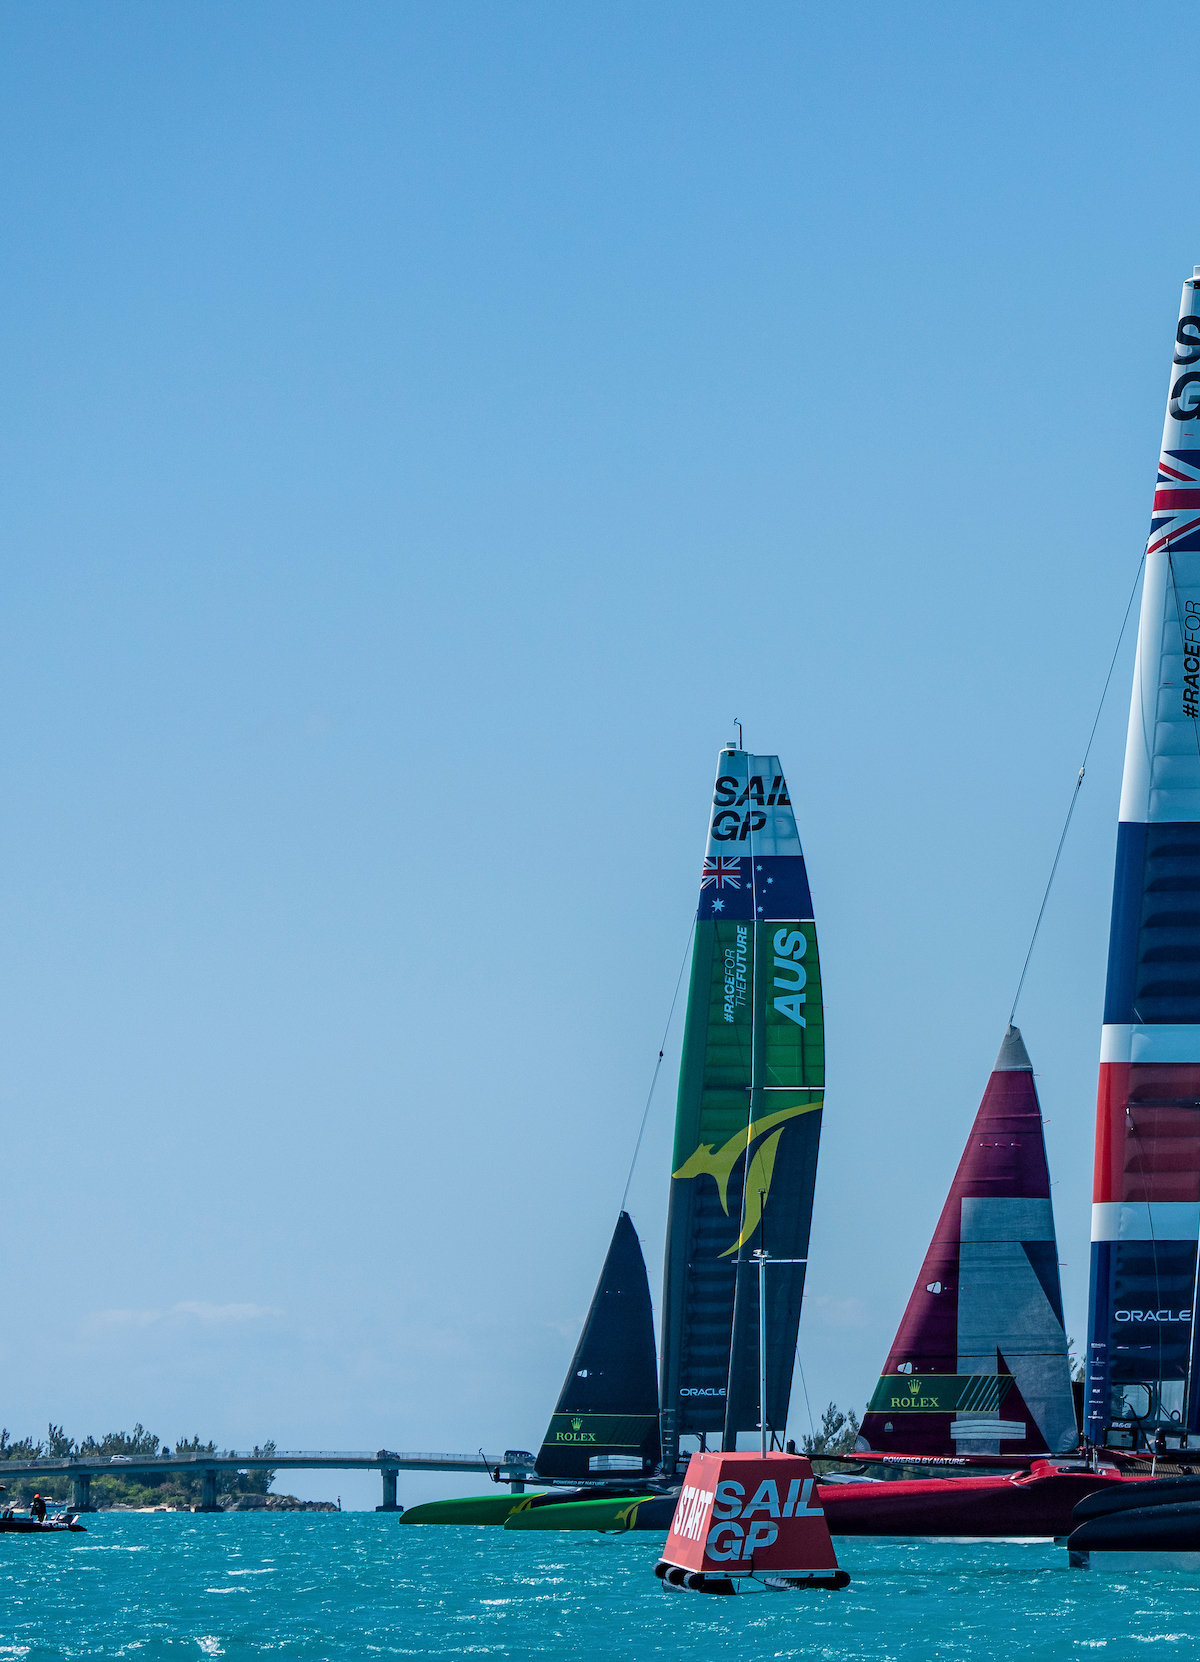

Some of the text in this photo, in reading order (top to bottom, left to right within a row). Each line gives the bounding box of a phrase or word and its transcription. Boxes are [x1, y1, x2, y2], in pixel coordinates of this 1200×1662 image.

[1182, 600, 1200, 719] #RACEFOR
[713, 775, 791, 807] SAIL
[710, 810, 767, 841] GP
[773, 928, 807, 1029] AUS
[1114, 1310, 1191, 1322] ORACLE
[680, 1388, 726, 1396] ORACLE
[890, 1397, 939, 1408] ROLEX
[555, 1432, 596, 1442] ROLEX
[883, 1456, 920, 1464] POWERED
[673, 1484, 714, 1542] START
[712, 1478, 824, 1519] SAIL
[705, 1520, 779, 1561] GP
